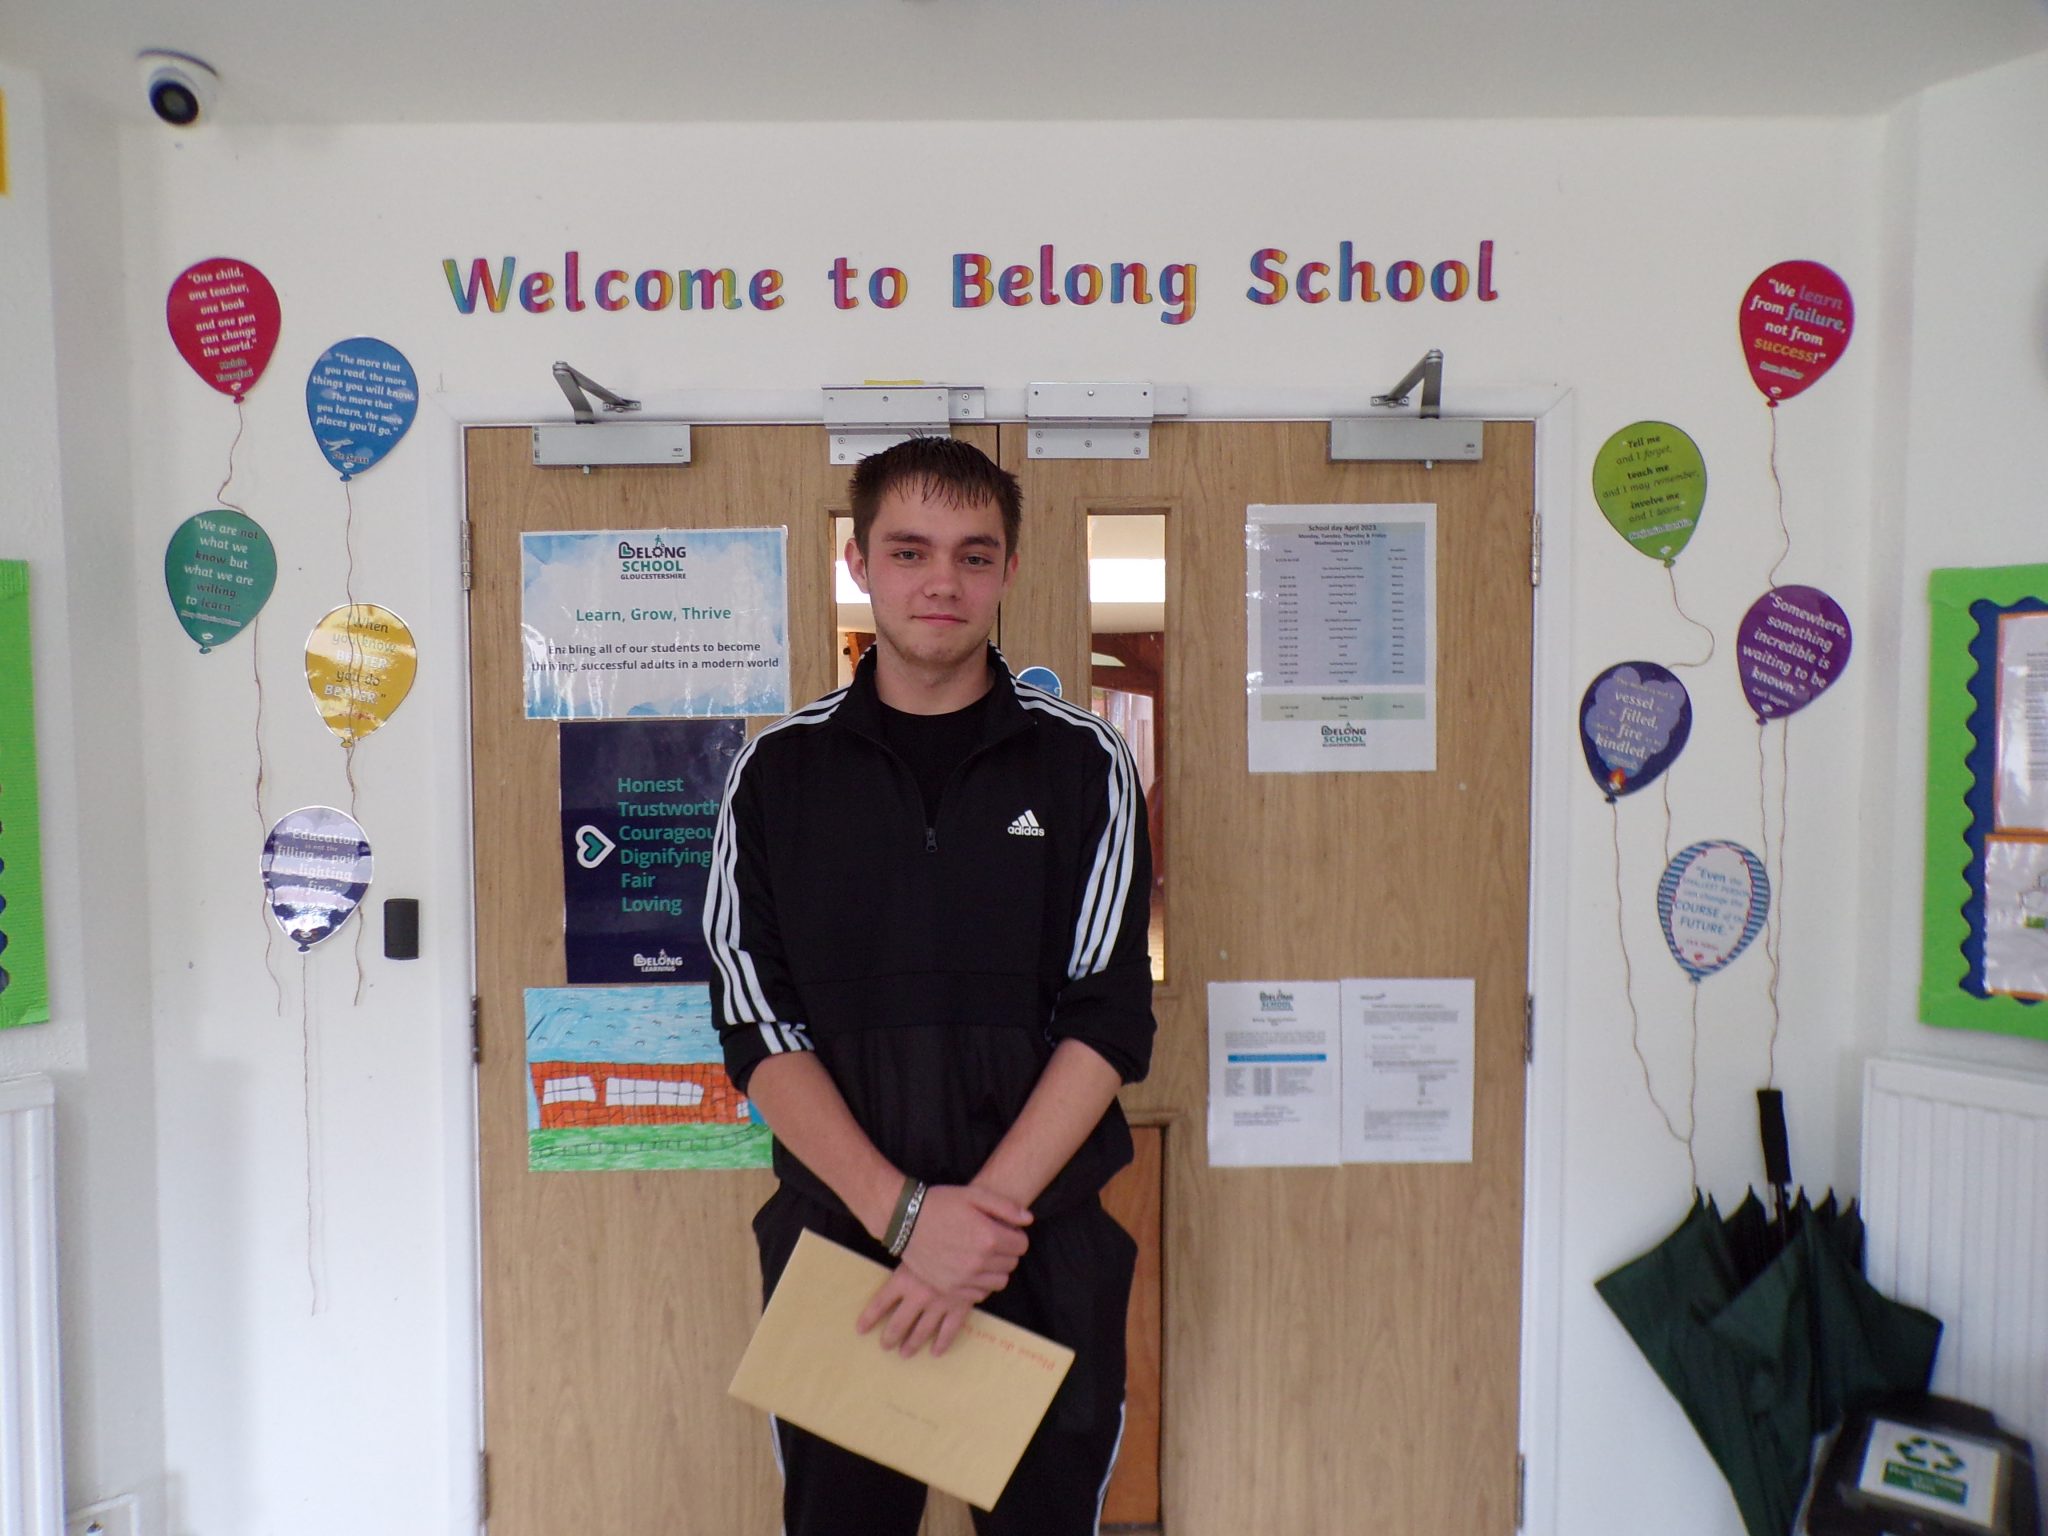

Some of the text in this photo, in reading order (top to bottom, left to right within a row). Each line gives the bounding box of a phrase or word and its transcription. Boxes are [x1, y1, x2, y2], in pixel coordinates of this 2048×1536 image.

[216, 267, 244, 281] child,
[442, 240, 1499, 325] Welcome to Belong School
[189, 283, 250, 301] one teacher,
[1799, 284, 1843, 310] learn
[200, 298, 245, 315] one book
[1750, 294, 1847, 334] from failure,
[196, 314, 256, 332] and one pen
[201, 328, 256, 344] can change
[1765, 322, 1824, 346] not from
[203, 347, 220, 358] the
[356, 358, 380, 368] more
[382, 360, 400, 372] that
[325, 366, 341, 376] you
[370, 372, 383, 382] the
[385, 376, 406, 386] more
[313, 376, 344, 388] things
[346, 382, 363, 392] you
[366, 385, 384, 396] will
[332, 392, 392, 410] The more that
[317, 404, 403, 425] you learn, the more
[316, 415, 347, 428] places
[350, 422, 376, 433] you'll
[1646, 436, 1661, 444] me
[1616, 453, 1634, 465] and
[1628, 464, 1670, 480] teach me
[1603, 486, 1620, 499] and
[1630, 482, 1650, 494] may
[1631, 492, 1680, 510] involve me
[1628, 511, 1647, 524] and
[219, 525, 238, 536] are
[240, 530, 259, 540] not
[200, 536, 248, 554] what we
[618, 542, 686, 558] BELONG
[196, 550, 249, 570] know but
[622, 560, 684, 572] SCHOOL
[184, 564, 254, 586] what we are
[196, 583, 237, 600] willing
[186, 596, 198, 606] to
[576, 606, 732, 623] Learn, Grow, Thrive
[1766, 615, 1834, 654] something
[362, 636, 396, 653] know
[599, 644, 612, 654] all
[615, 644, 627, 653] of
[629, 645, 648, 653] our
[651, 643, 700, 652] students
[703, 644, 714, 652] to
[718, 642, 760, 652] become
[1754, 626, 1831, 670] incredible is
[580, 660, 637, 670] successful
[640, 660, 675, 670] adults
[678, 660, 689, 668] in
[692, 661, 698, 669] a
[702, 658, 744, 668] modern
[747, 658, 779, 668] world
[1743, 645, 1828, 688] waiting to be
[364, 674, 380, 686] do
[1616, 692, 1655, 710] vessel
[1322, 726, 1366, 736] BELONG
[1617, 724, 1642, 739] fire
[618, 778, 684, 793] Honest
[618, 800, 720, 817] Trustworth
[619, 826, 714, 844] Courageou
[1008, 826, 1044, 836] adidas
[278, 844, 314, 862] filling
[620, 848, 712, 869] Dignifying
[622, 872, 656, 888] Fair
[622, 896, 682, 916] Loving
[634, 954, 683, 966] BELONG
